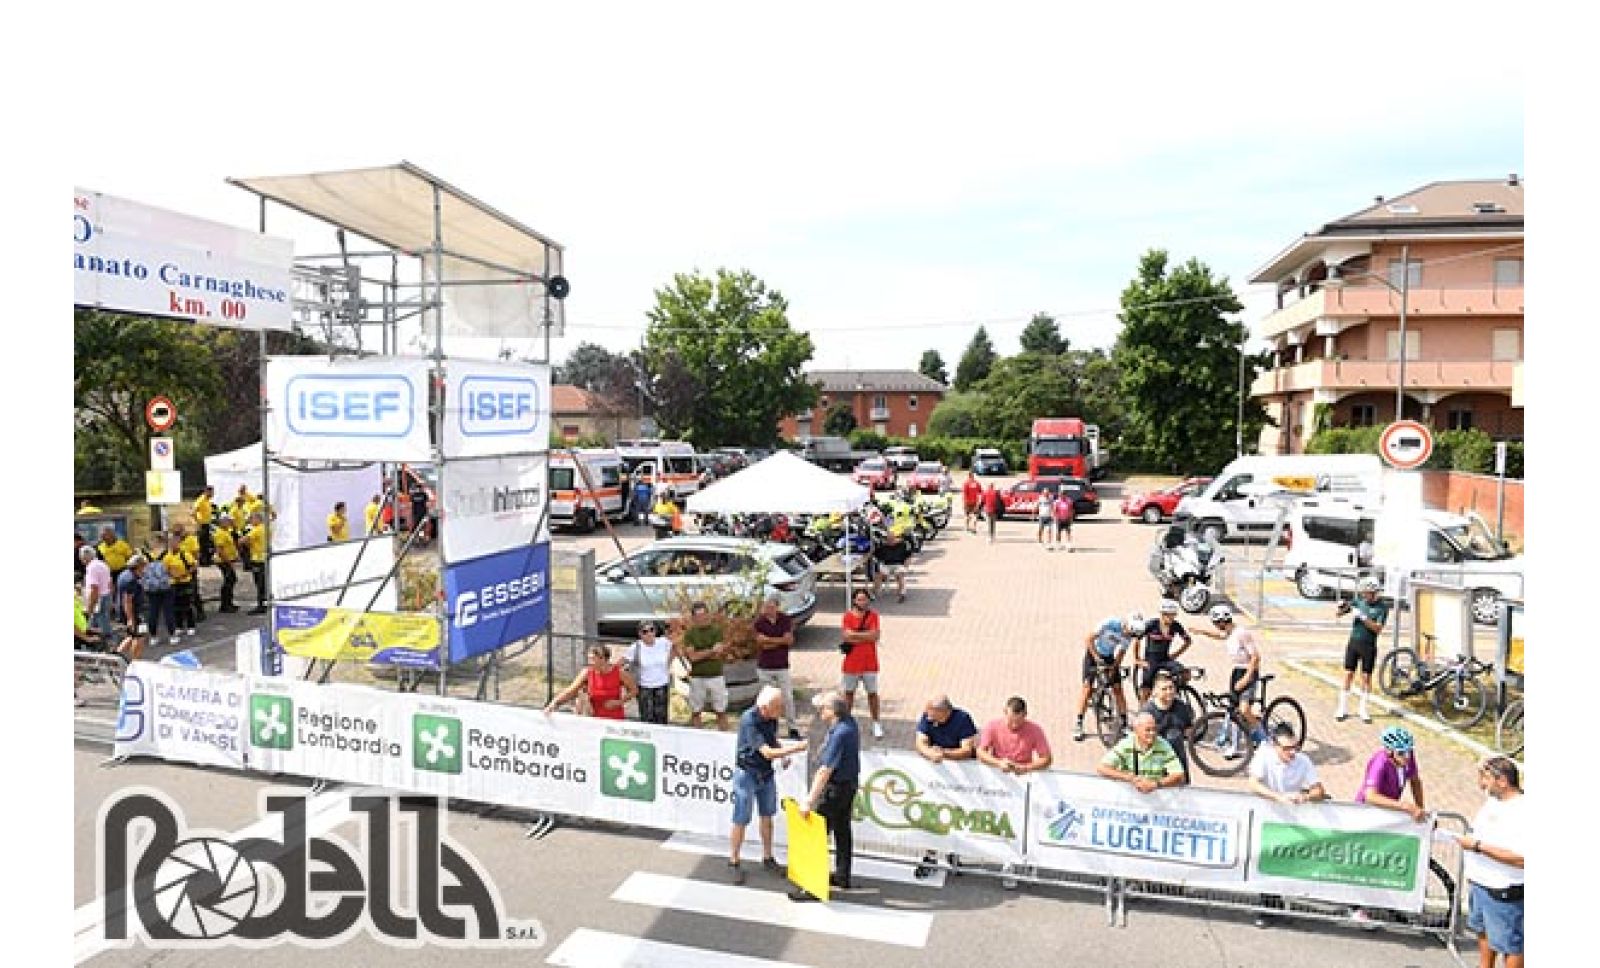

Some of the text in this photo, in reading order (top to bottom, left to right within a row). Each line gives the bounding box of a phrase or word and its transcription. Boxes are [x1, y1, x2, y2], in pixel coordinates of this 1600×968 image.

[74, 253, 287, 302] anato Carnaghese
[169, 289, 246, 319] km. 00
[298, 390, 401, 421] ISEF
[469, 391, 531, 421] ISEF
[156, 682, 242, 708] CAMERA DI
[159, 723, 174, 739] DI
[298, 706, 378, 734] Regione
[298, 728, 402, 757] Lombardia
[467, 728, 560, 758] Regione
[467, 750, 587, 783] Lombardia
[1091, 806, 1228, 834] OFFICINA MECCANICA
[1091, 821, 1227, 862] LUGLIETTI
